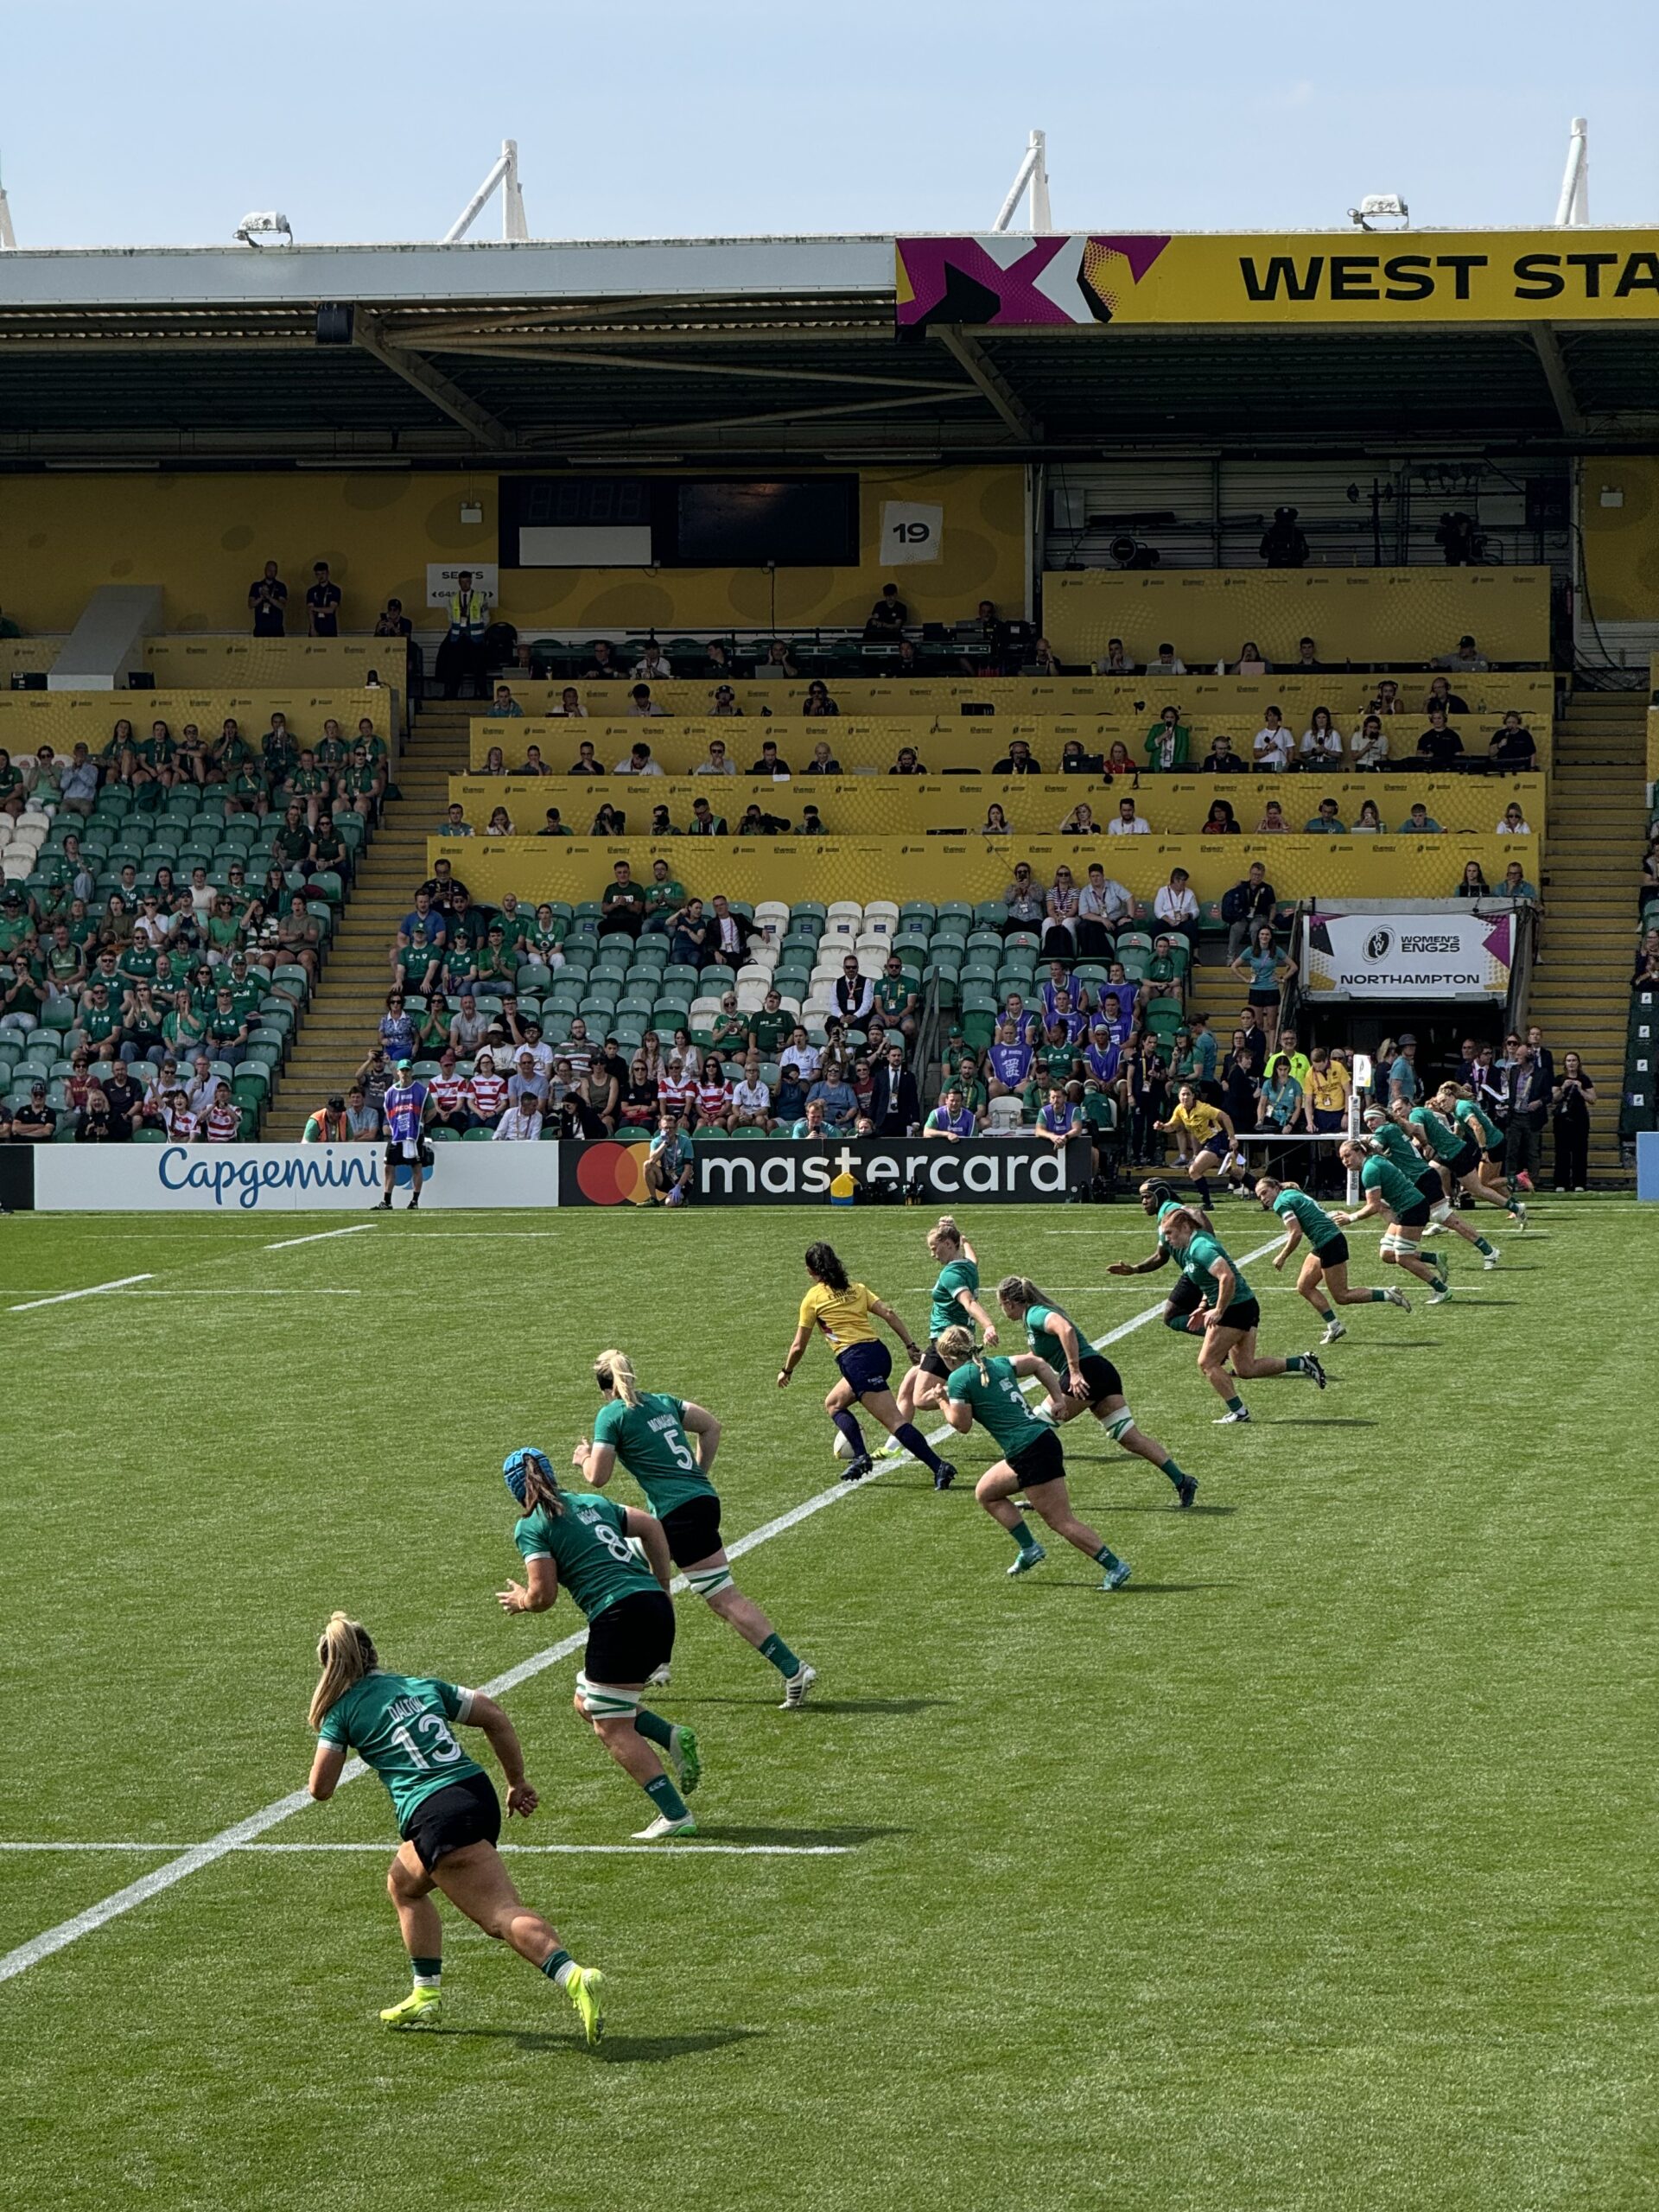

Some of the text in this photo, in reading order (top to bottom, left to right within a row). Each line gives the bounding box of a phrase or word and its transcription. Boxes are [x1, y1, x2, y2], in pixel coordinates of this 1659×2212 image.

[1238, 252, 1659, 302] WEST STA
[893, 523, 930, 543] 19
[1401, 943, 1460, 953] ENG25
[1340, 974, 1480, 984] NORTHAMPTON
[158, 1147, 382, 1209] Capgemini
[702, 1146, 1067, 1193] mastercard
[664, 1429, 693, 1470] 5
[594, 1524, 632, 1563] 8
[387, 1695, 428, 1723] DALTON
[391, 1713, 461, 1769] 13
